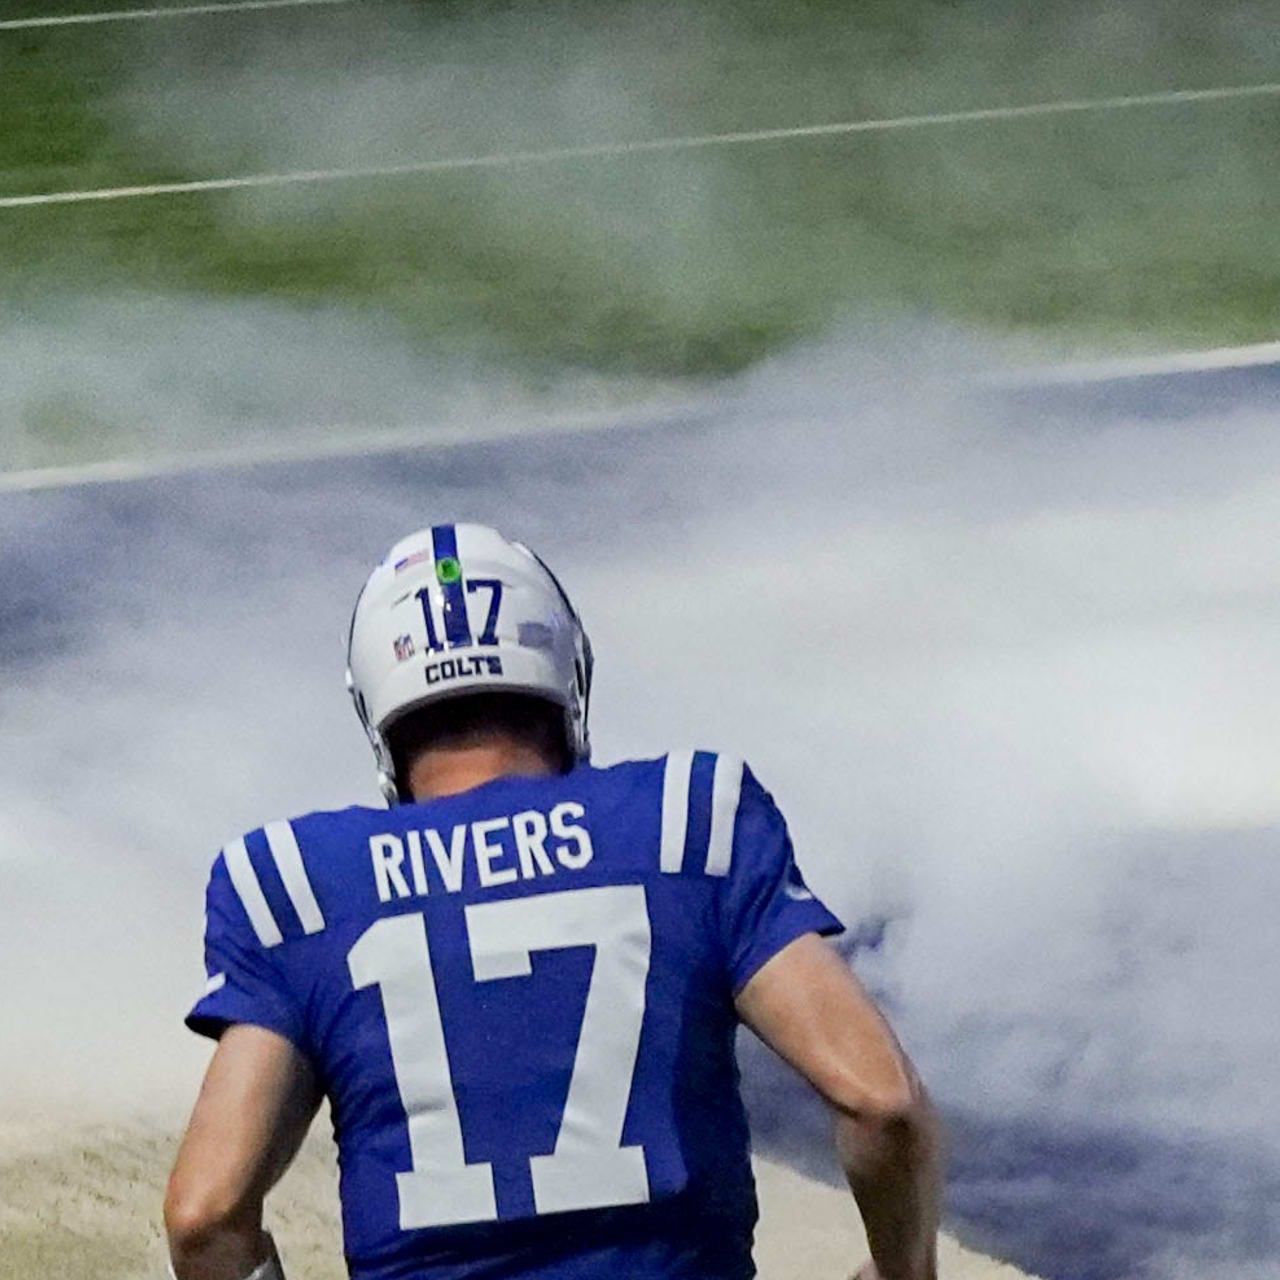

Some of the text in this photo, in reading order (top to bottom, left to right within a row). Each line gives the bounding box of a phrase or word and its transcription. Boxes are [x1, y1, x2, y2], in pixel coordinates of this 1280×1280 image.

[414, 579, 503, 654] 17
[424, 656, 504, 685] COLTS
[369, 802, 595, 902] RIVERS
[347, 885, 652, 1231] 17
